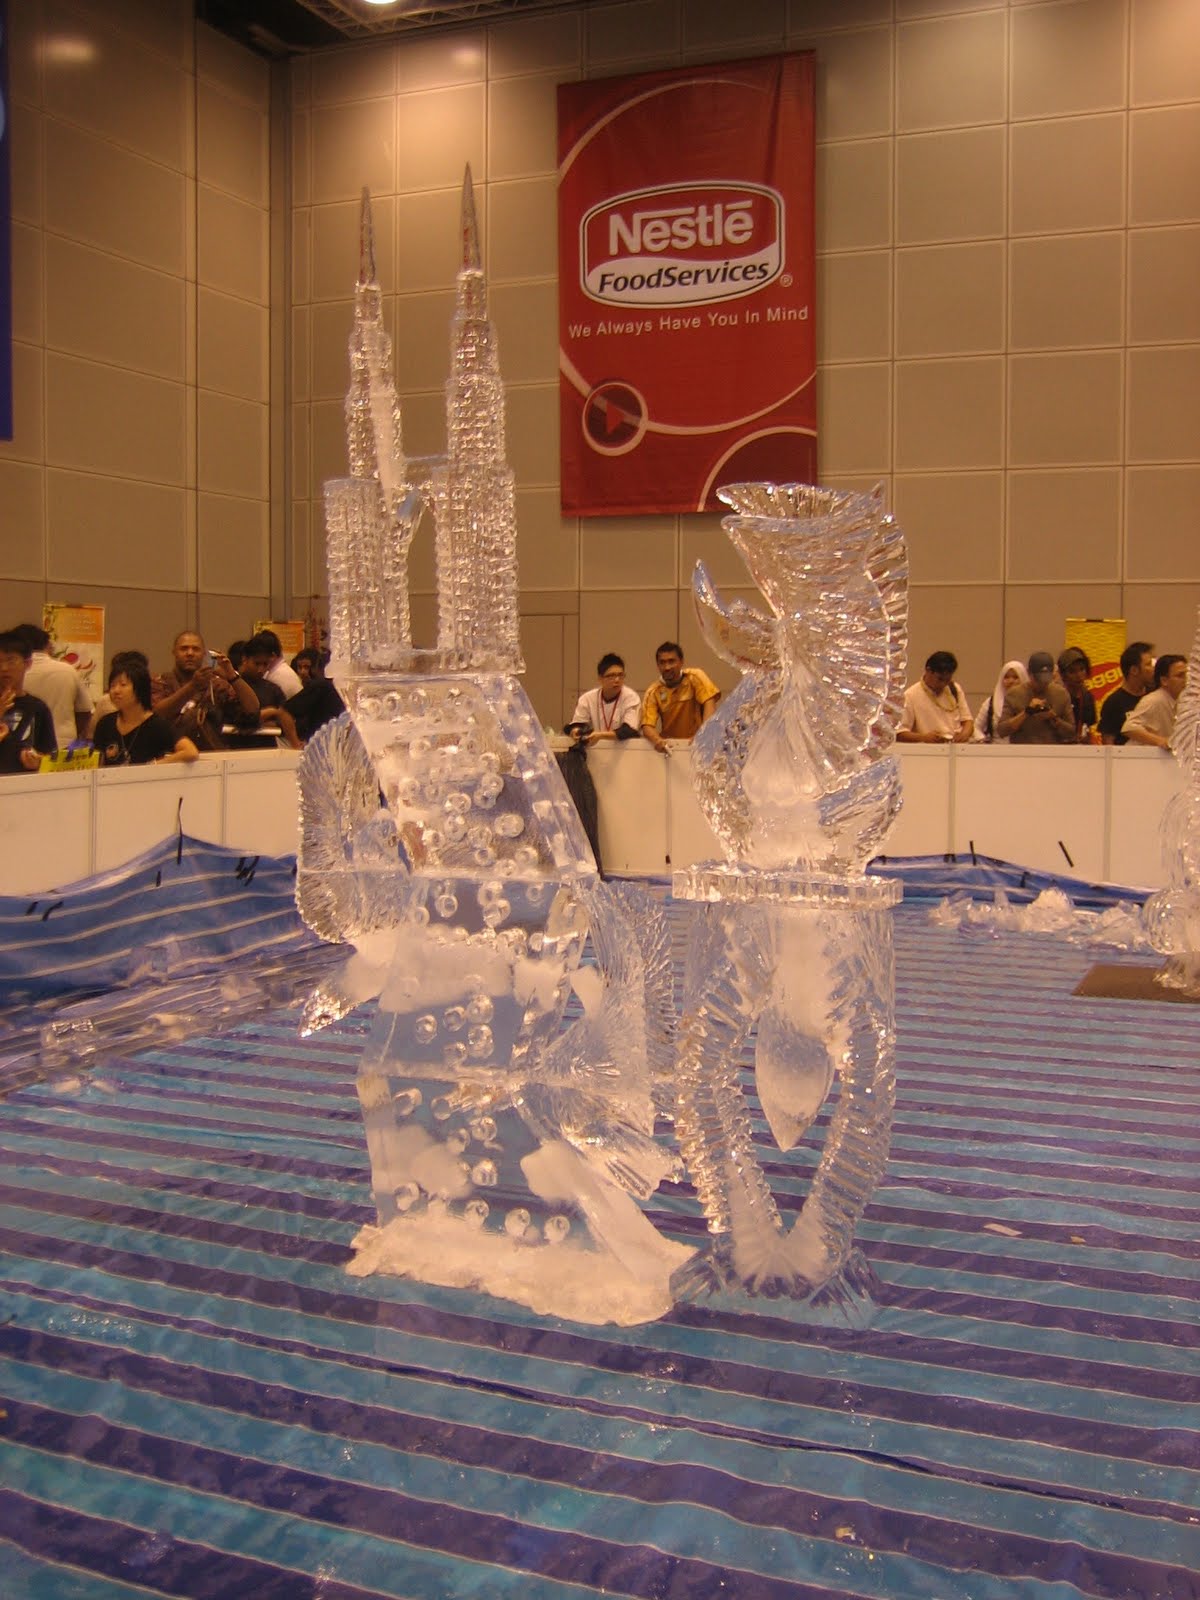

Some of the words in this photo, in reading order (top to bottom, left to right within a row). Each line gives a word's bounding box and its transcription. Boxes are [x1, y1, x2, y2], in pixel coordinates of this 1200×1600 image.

[598, 260, 769, 294] FoodServices
[568, 323, 591, 339] We
[597, 319, 652, 337] Always
[659, 314, 701, 331] Have
[708, 310, 738, 327] You
[745, 308, 760, 324] In
[767, 305, 809, 322] Mind
